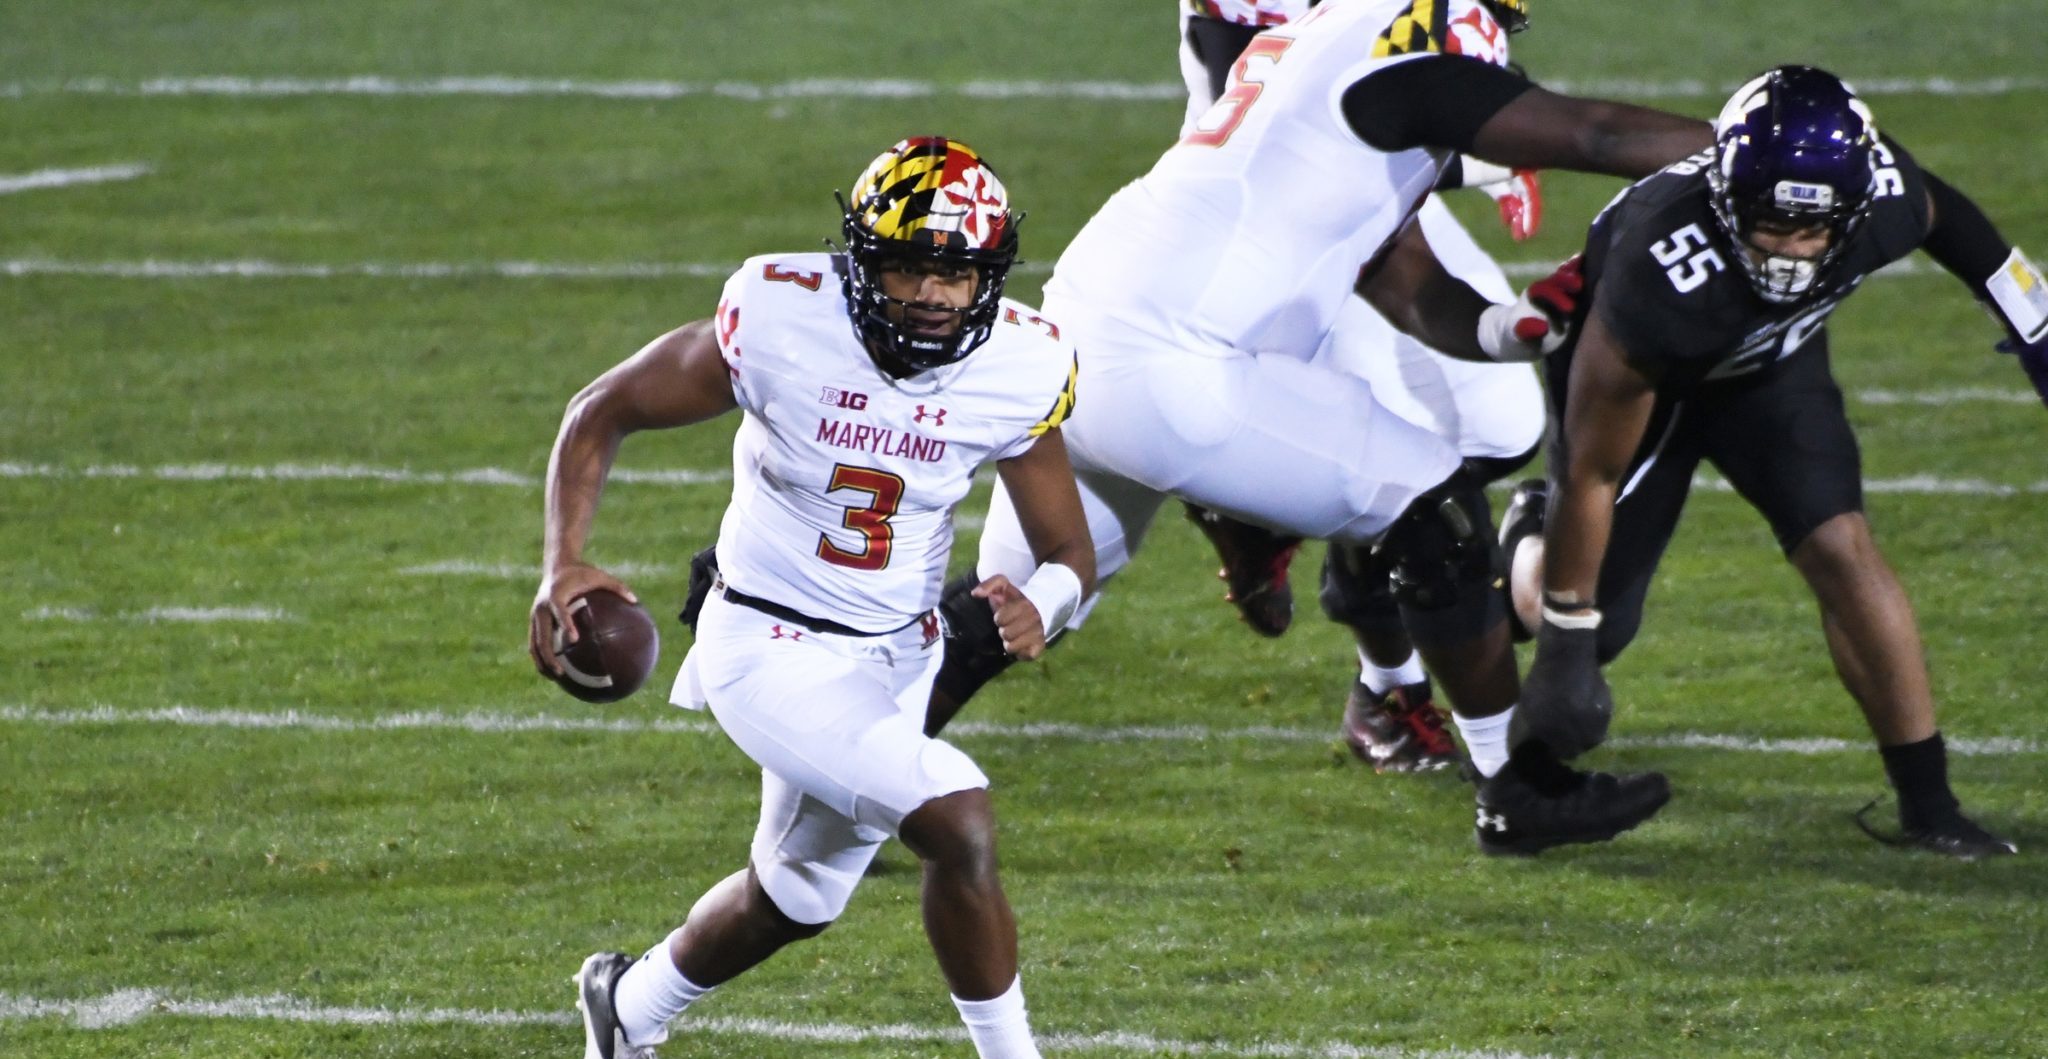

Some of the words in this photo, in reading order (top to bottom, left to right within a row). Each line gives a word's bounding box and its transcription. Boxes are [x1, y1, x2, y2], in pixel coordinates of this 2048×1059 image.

[933, 231, 949, 245] M
[1649, 222, 1726, 293] 55
[816, 418, 946, 463] MARYLAND
[816, 462, 905, 571] 3
